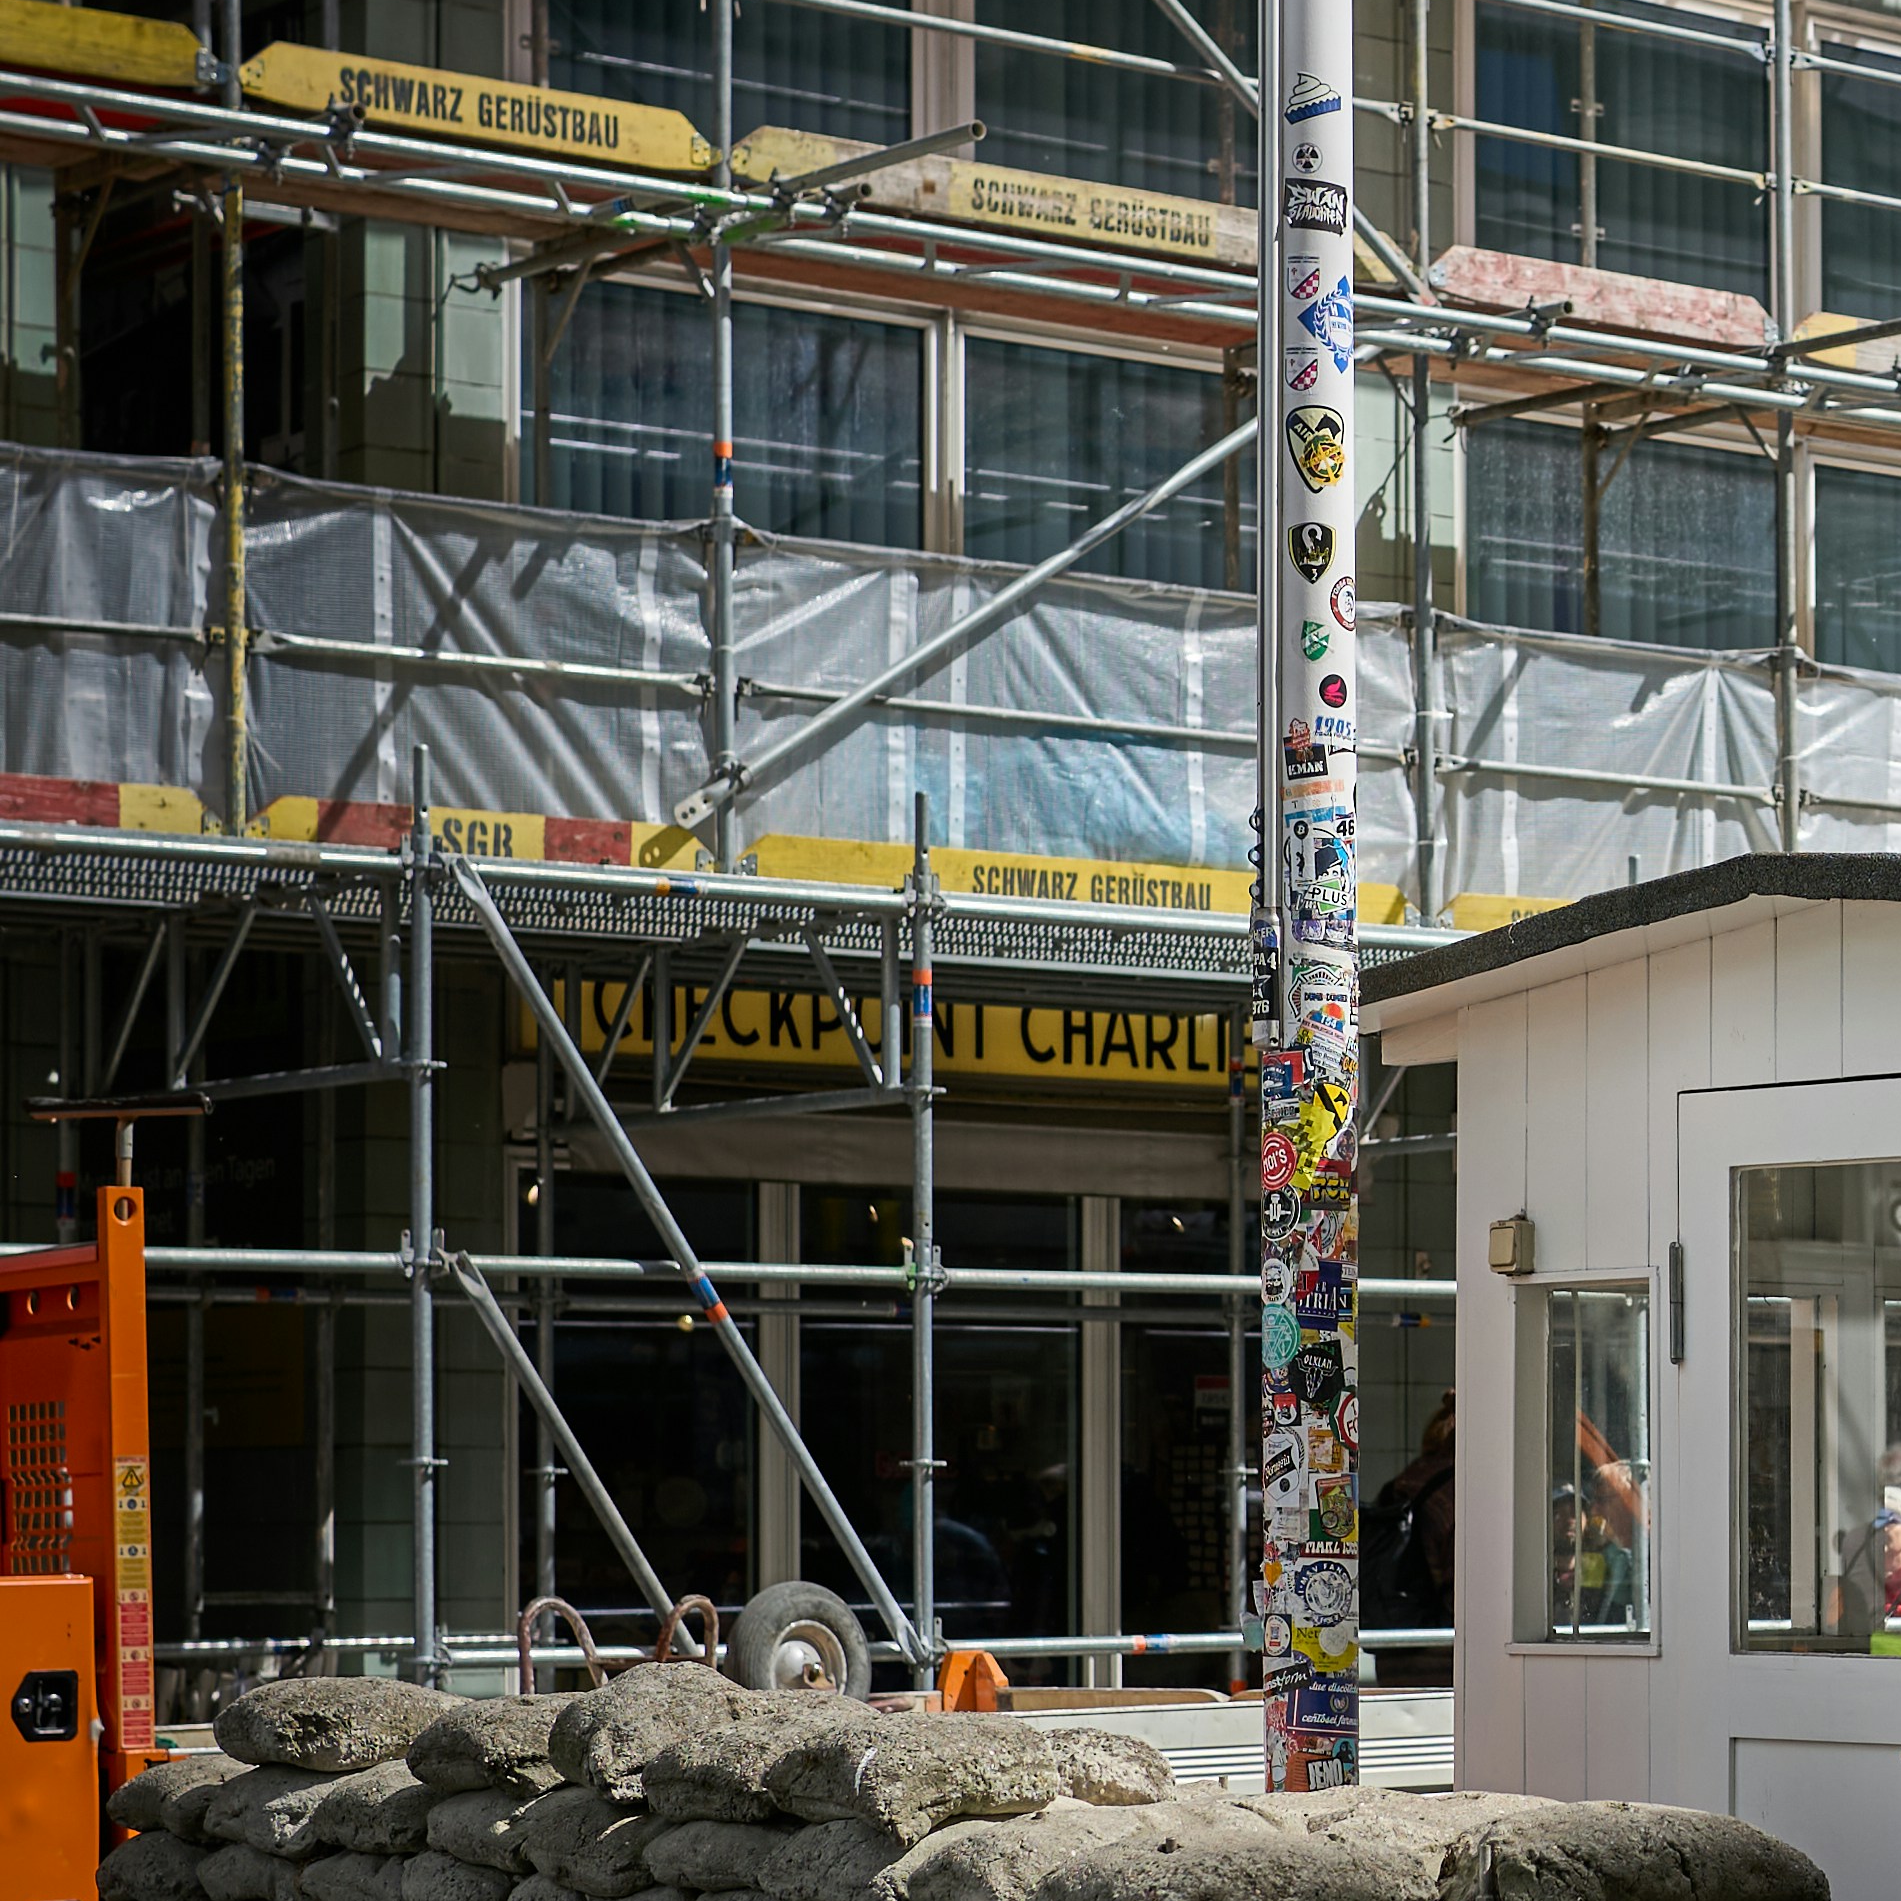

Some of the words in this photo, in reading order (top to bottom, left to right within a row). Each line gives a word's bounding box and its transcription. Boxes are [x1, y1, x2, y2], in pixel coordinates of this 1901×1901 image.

[339, 67, 463, 124] SCHWARZ
[478, 93, 619, 150] GERÜSTBAU
[971, 176, 1079, 227] SCHWARZ
[1088, 197, 1212, 248] GERÜSTBAU
[442, 818, 513, 858] SGB
[972, 864, 1078, 901] SCHWARZ
[1090, 872, 1212, 911] GERÜSTBAU
[1021, 1007, 1257, 1074] CHARLI
[227, 1155, 276, 1187] Tagen
